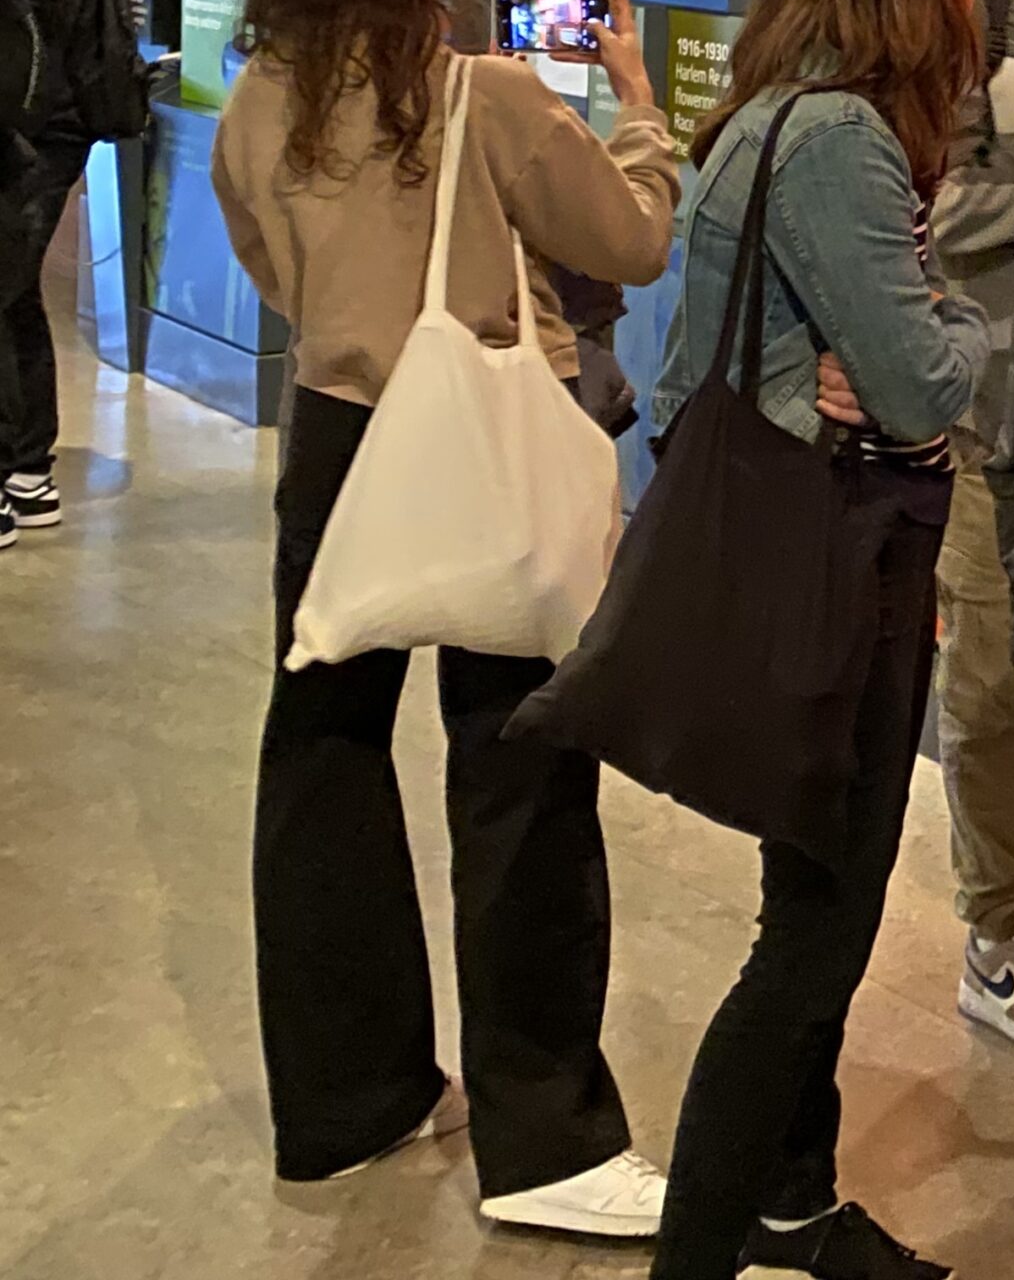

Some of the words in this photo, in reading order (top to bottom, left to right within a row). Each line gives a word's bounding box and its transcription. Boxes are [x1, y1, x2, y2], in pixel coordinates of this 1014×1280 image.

[676, 37, 730, 62] 1916-1930
[675, 61, 708, 85] Harlem
[673, 111, 695, 133] Race
